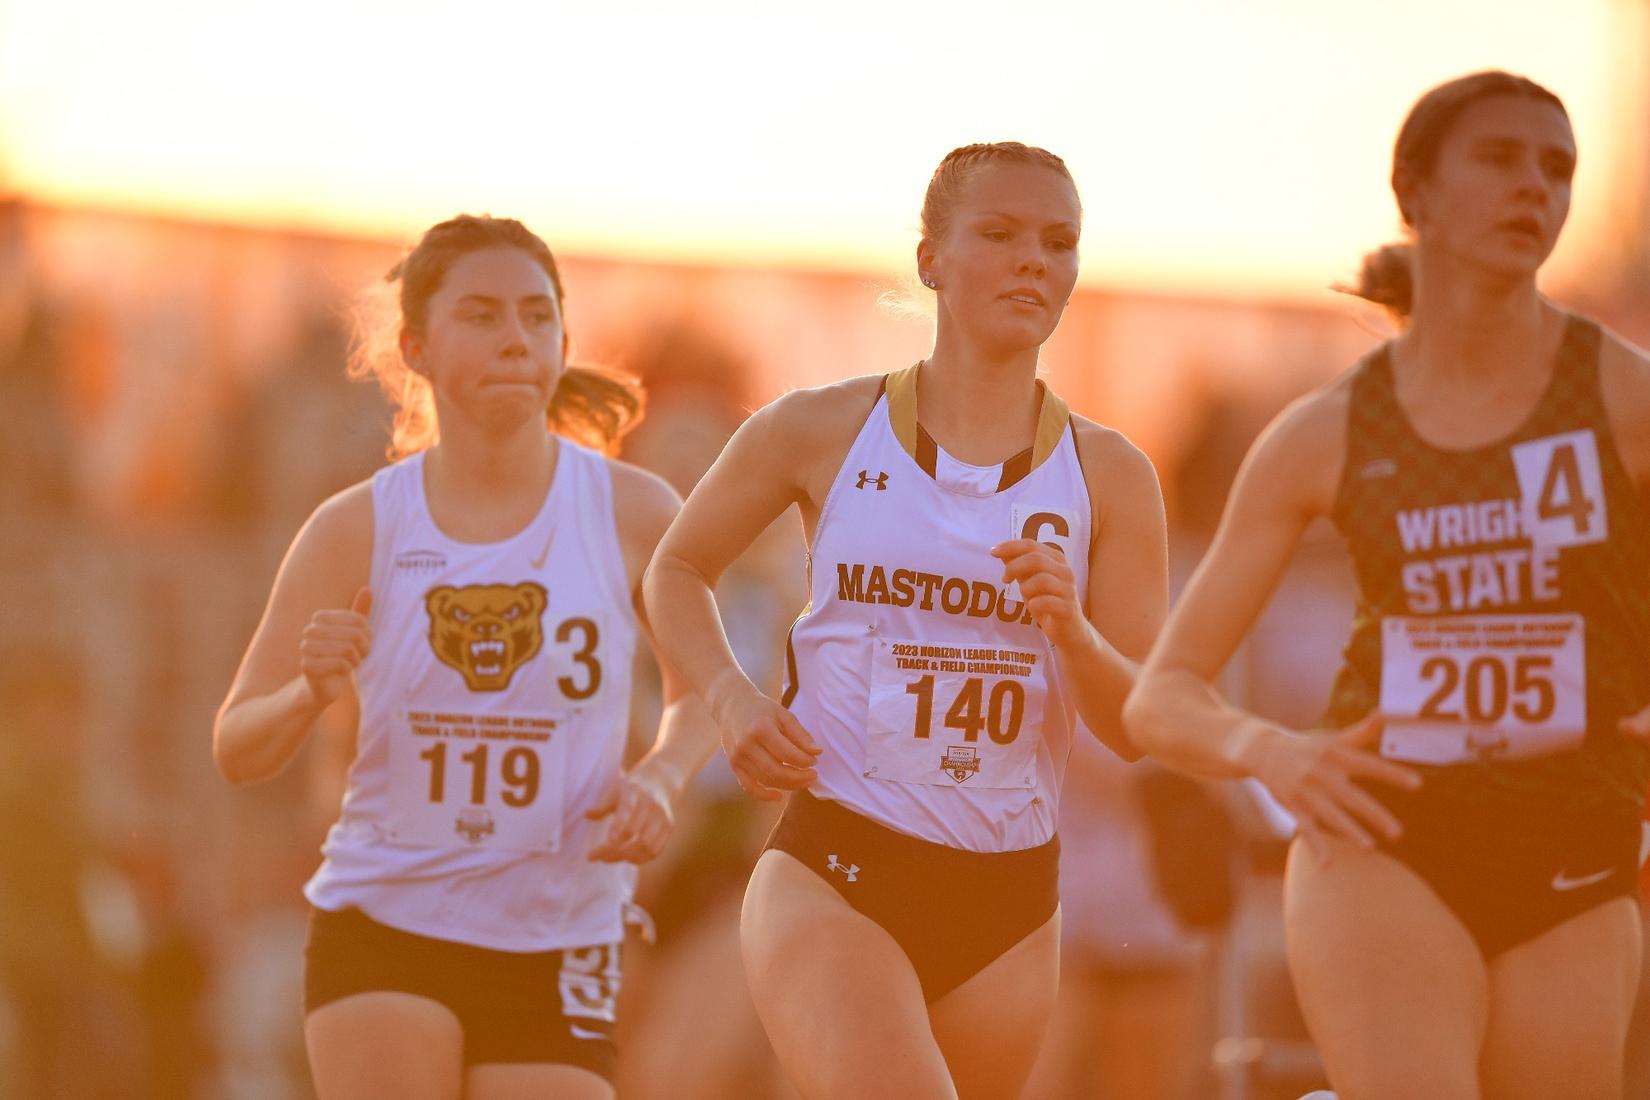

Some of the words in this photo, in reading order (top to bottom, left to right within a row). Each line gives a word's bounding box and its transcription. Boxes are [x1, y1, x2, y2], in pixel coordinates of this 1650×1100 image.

[1537, 443, 1595, 535] 4
[1396, 500, 1533, 552] WRIGH
[836, 563, 1042, 630] MASTODO
[1402, 547, 1561, 614] STATE
[555, 617, 602, 700] 3
[892, 643, 919, 657] 2023
[920, 645, 961, 659] HORIZON
[963, 648, 997, 661] LEAGUE
[896, 657, 929, 671] TRACK
[931, 661, 938, 671] &
[940, 660, 965, 673] FIELD
[967, 662, 1032, 677] CHAMPIONSHIP
[906, 674, 1025, 745] 140
[1418, 655, 1556, 724] 205
[419, 741, 541, 809] 119
